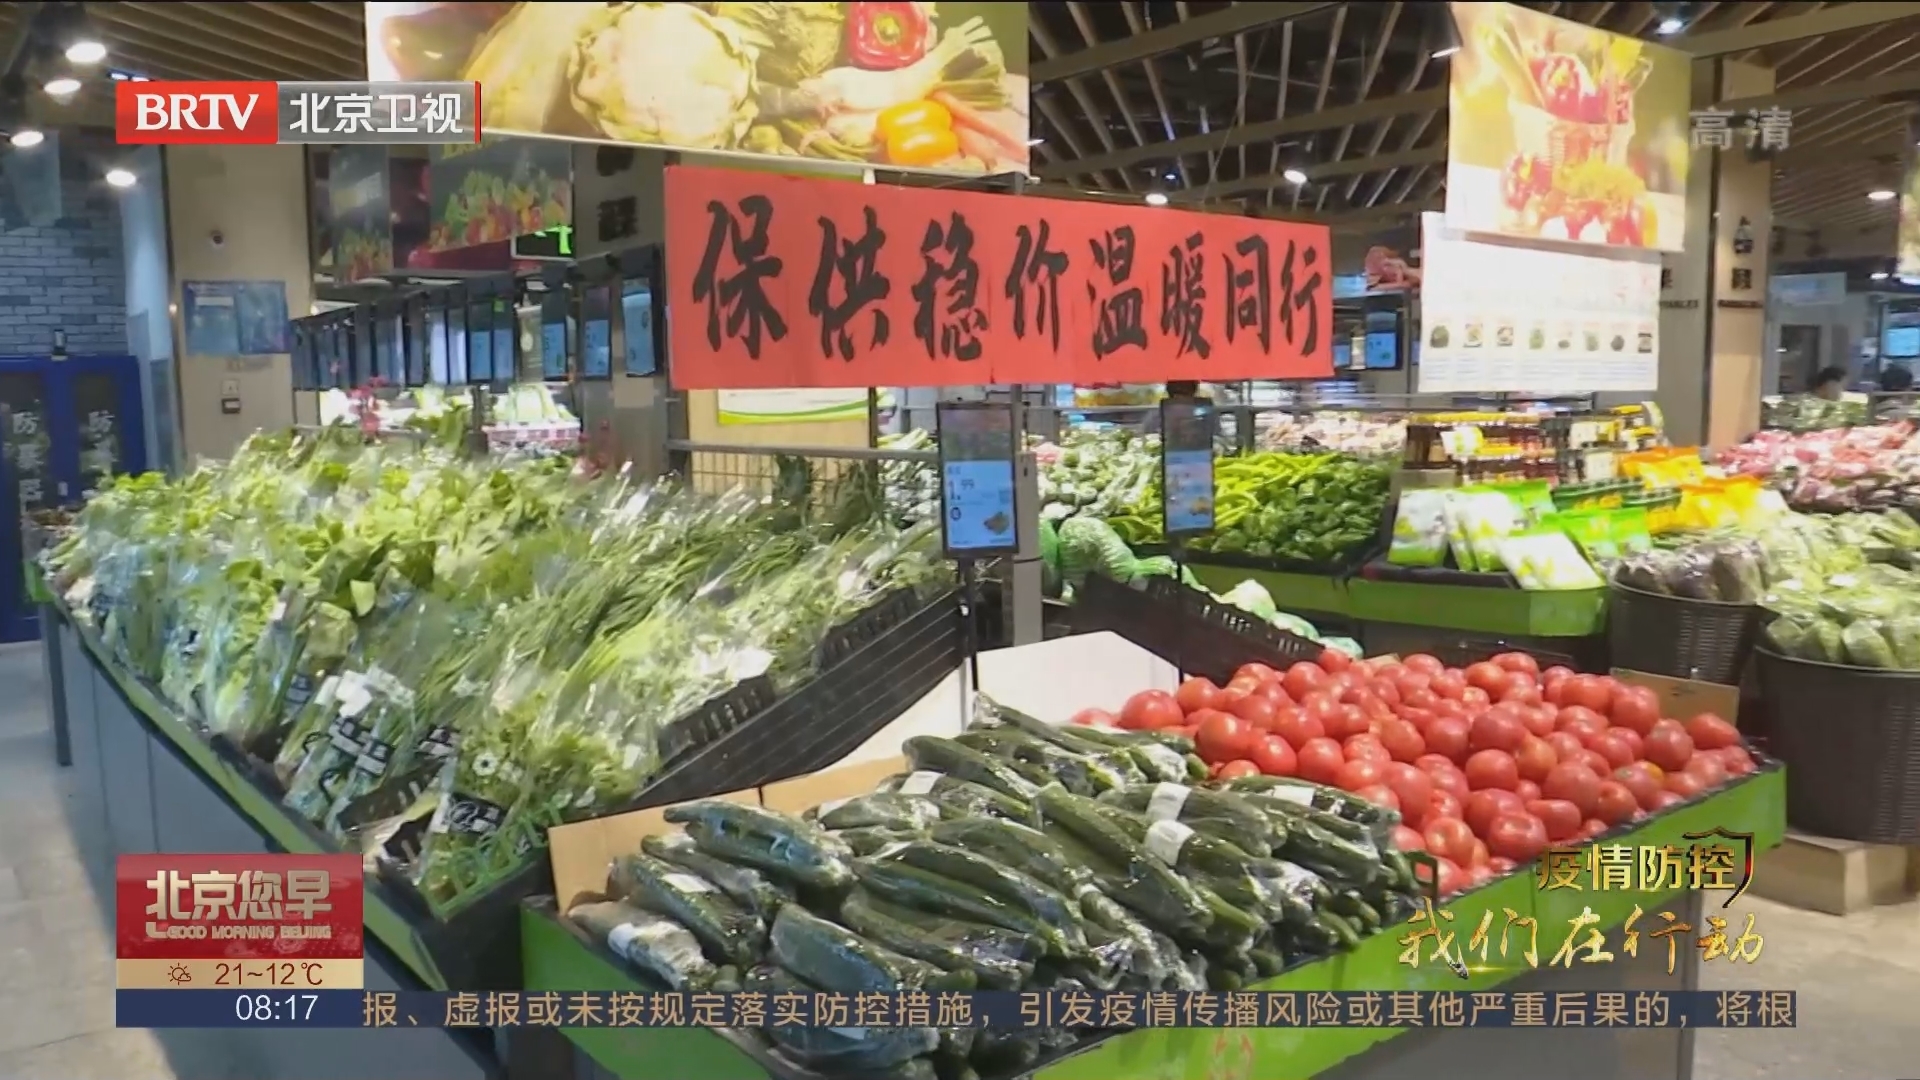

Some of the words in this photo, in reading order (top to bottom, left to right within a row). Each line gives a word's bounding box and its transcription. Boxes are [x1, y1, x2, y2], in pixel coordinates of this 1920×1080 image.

[692, 195, 1323, 361] 保供稳价温暖同行
